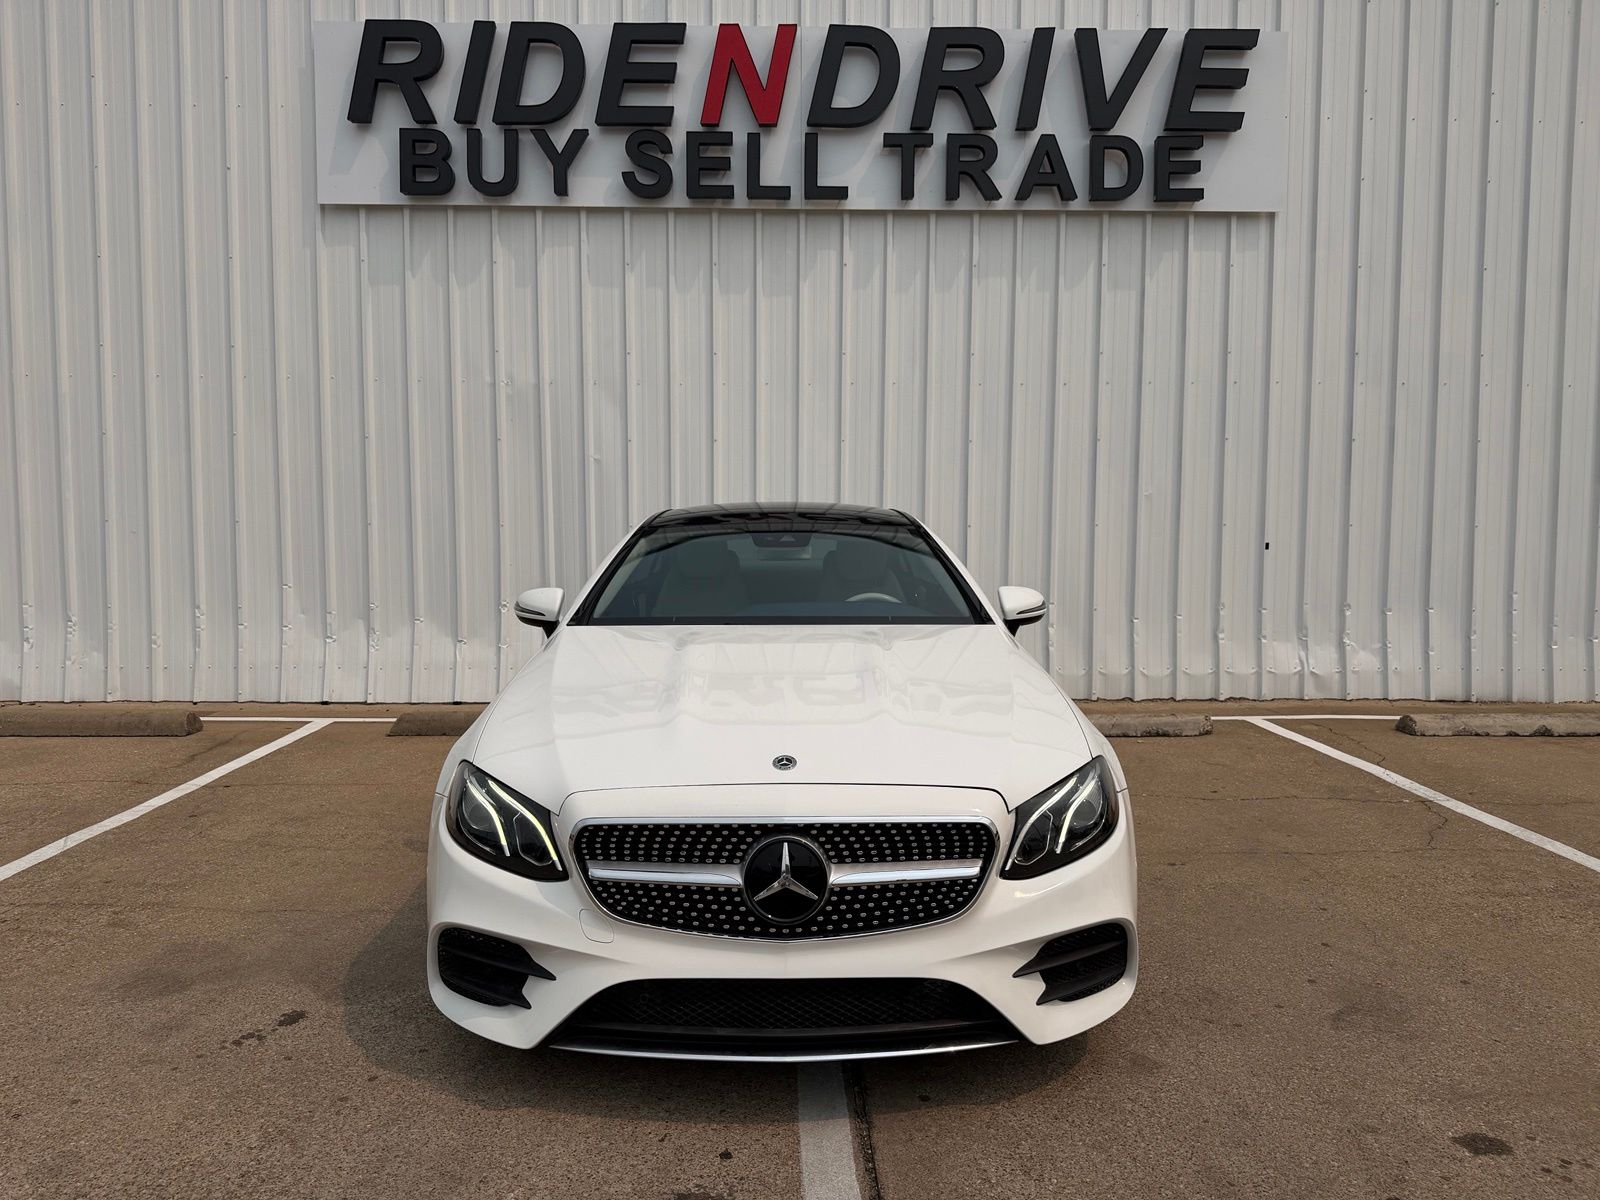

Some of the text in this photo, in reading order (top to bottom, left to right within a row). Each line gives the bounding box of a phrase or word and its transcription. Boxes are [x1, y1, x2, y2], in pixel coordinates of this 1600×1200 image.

[400, 127, 1205, 202] BUY SELL TRADE
